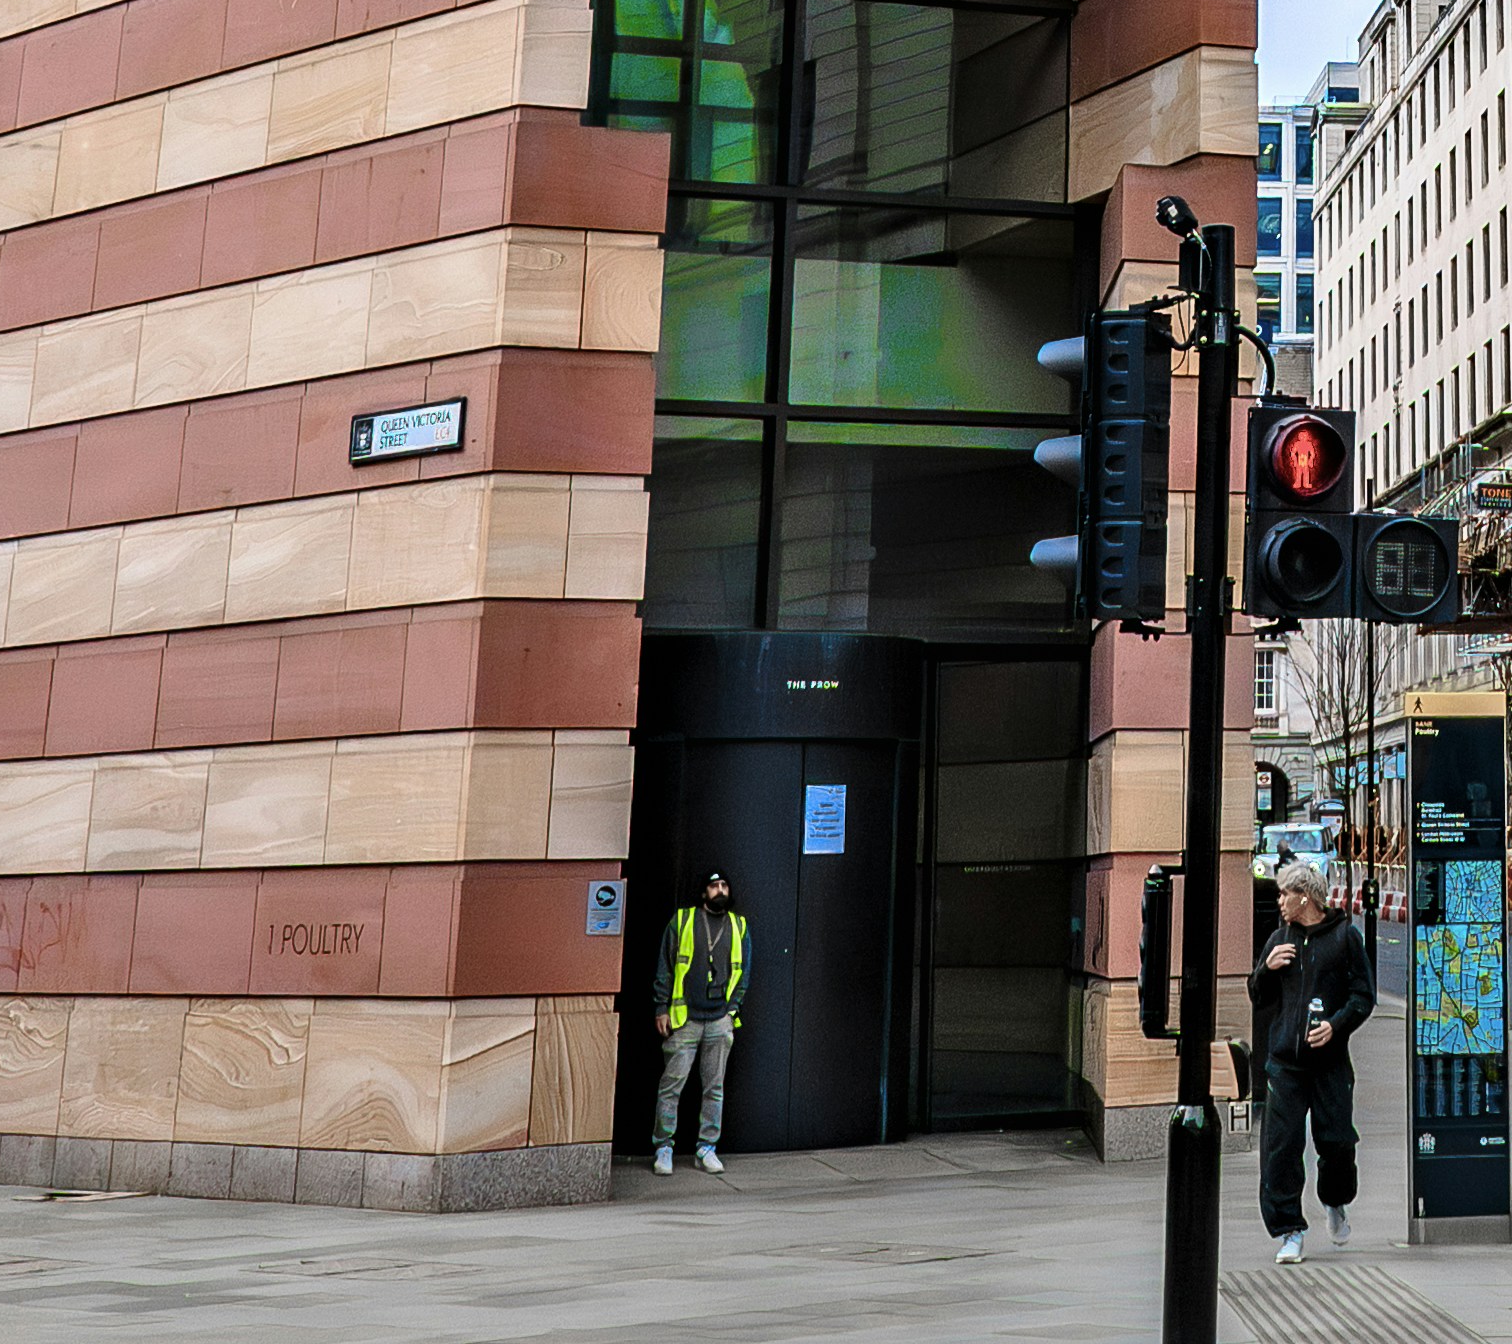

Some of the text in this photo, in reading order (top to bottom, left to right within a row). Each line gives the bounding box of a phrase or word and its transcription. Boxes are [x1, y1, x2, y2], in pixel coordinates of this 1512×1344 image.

[380, 409, 451, 434] QUEEN VICTORIA
[379, 432, 408, 450] STREET
[787, 680, 806, 690] THE
[280, 923, 365, 956] POULTRY
[1230, 1102, 1250, 1132] H
